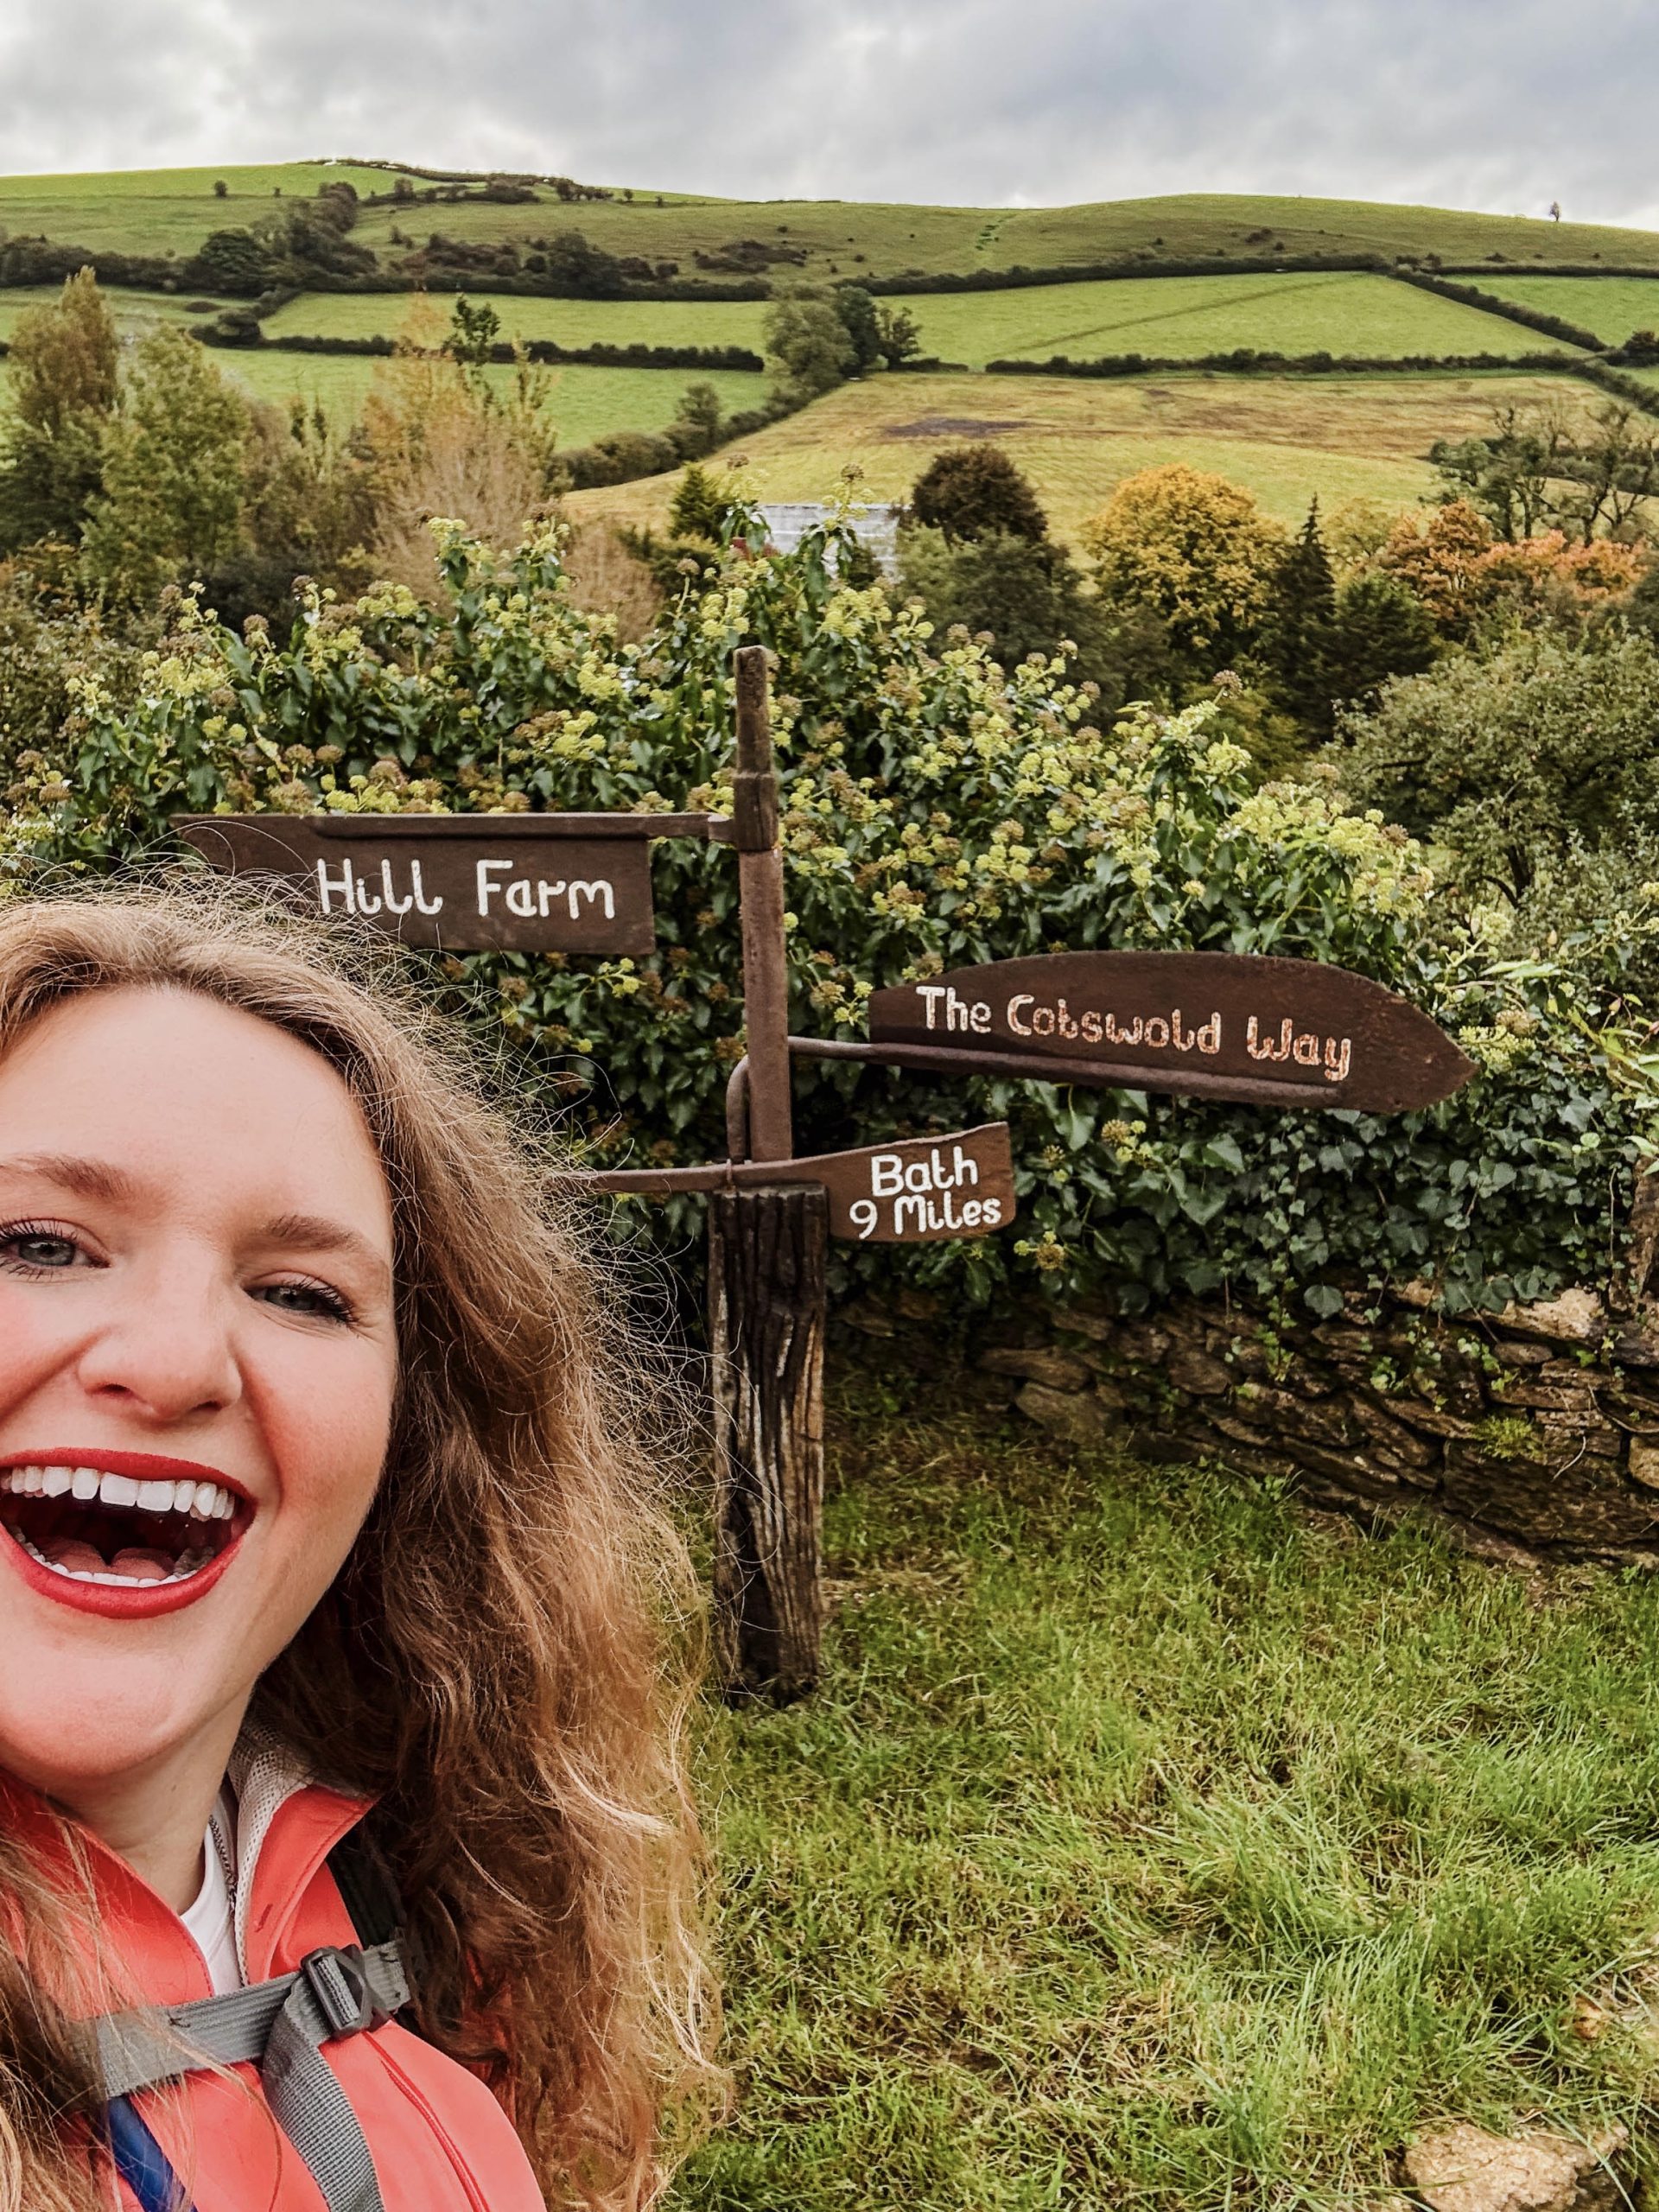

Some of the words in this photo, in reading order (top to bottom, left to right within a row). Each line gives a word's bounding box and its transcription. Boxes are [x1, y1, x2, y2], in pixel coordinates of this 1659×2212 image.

[315, 858, 443, 915] Hill
[476, 859, 615, 919] Farm
[915, 986, 992, 1034] The
[1007, 994, 1221, 1055] Cotswold
[1246, 1015, 1351, 1082] Way
[871, 1146, 978, 1197] Bath
[849, 1199, 878, 1239] 9
[894, 1191, 1001, 1235] Miles
